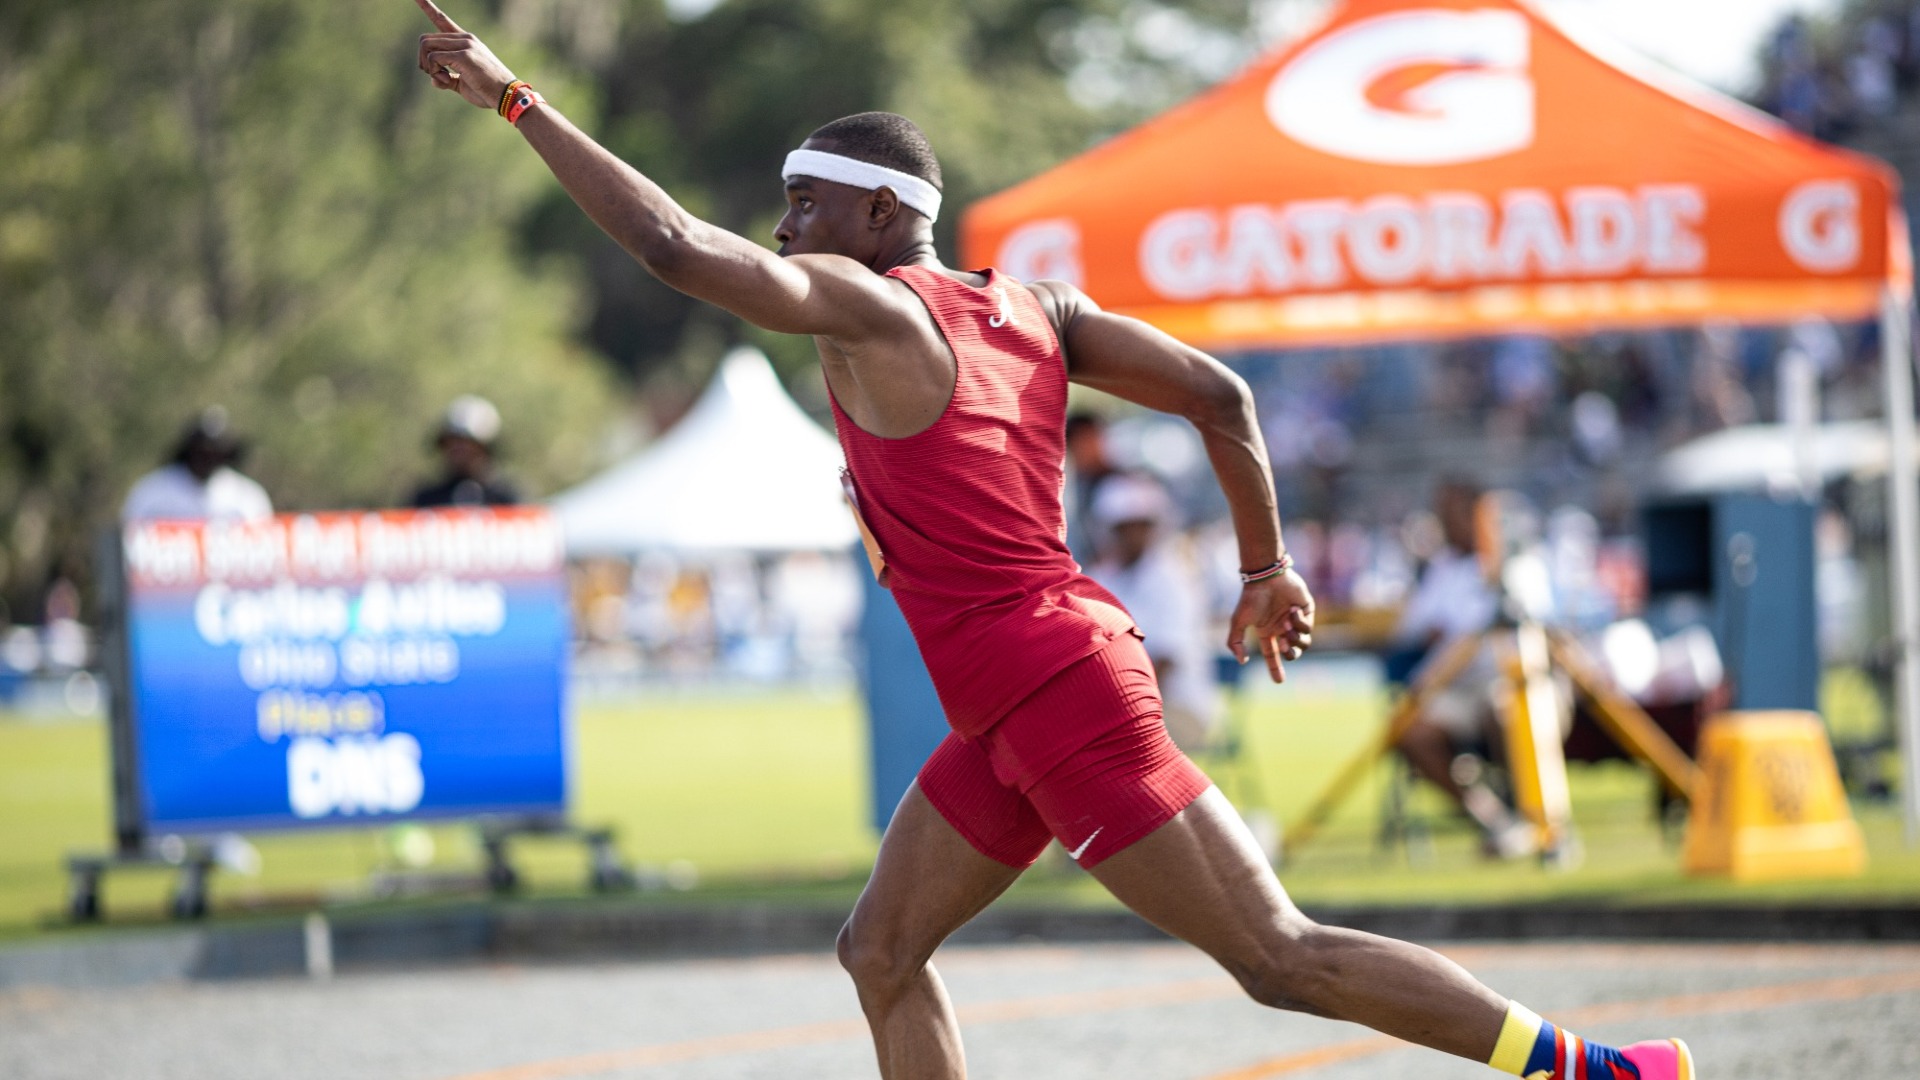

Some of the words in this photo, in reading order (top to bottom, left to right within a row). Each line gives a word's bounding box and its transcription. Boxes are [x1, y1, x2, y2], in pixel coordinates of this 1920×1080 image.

[1266, 9, 1535, 165] G
[1139, 186, 1707, 300] GATORADE
[1778, 179, 1860, 272] G
[287, 733, 424, 817] DNS
